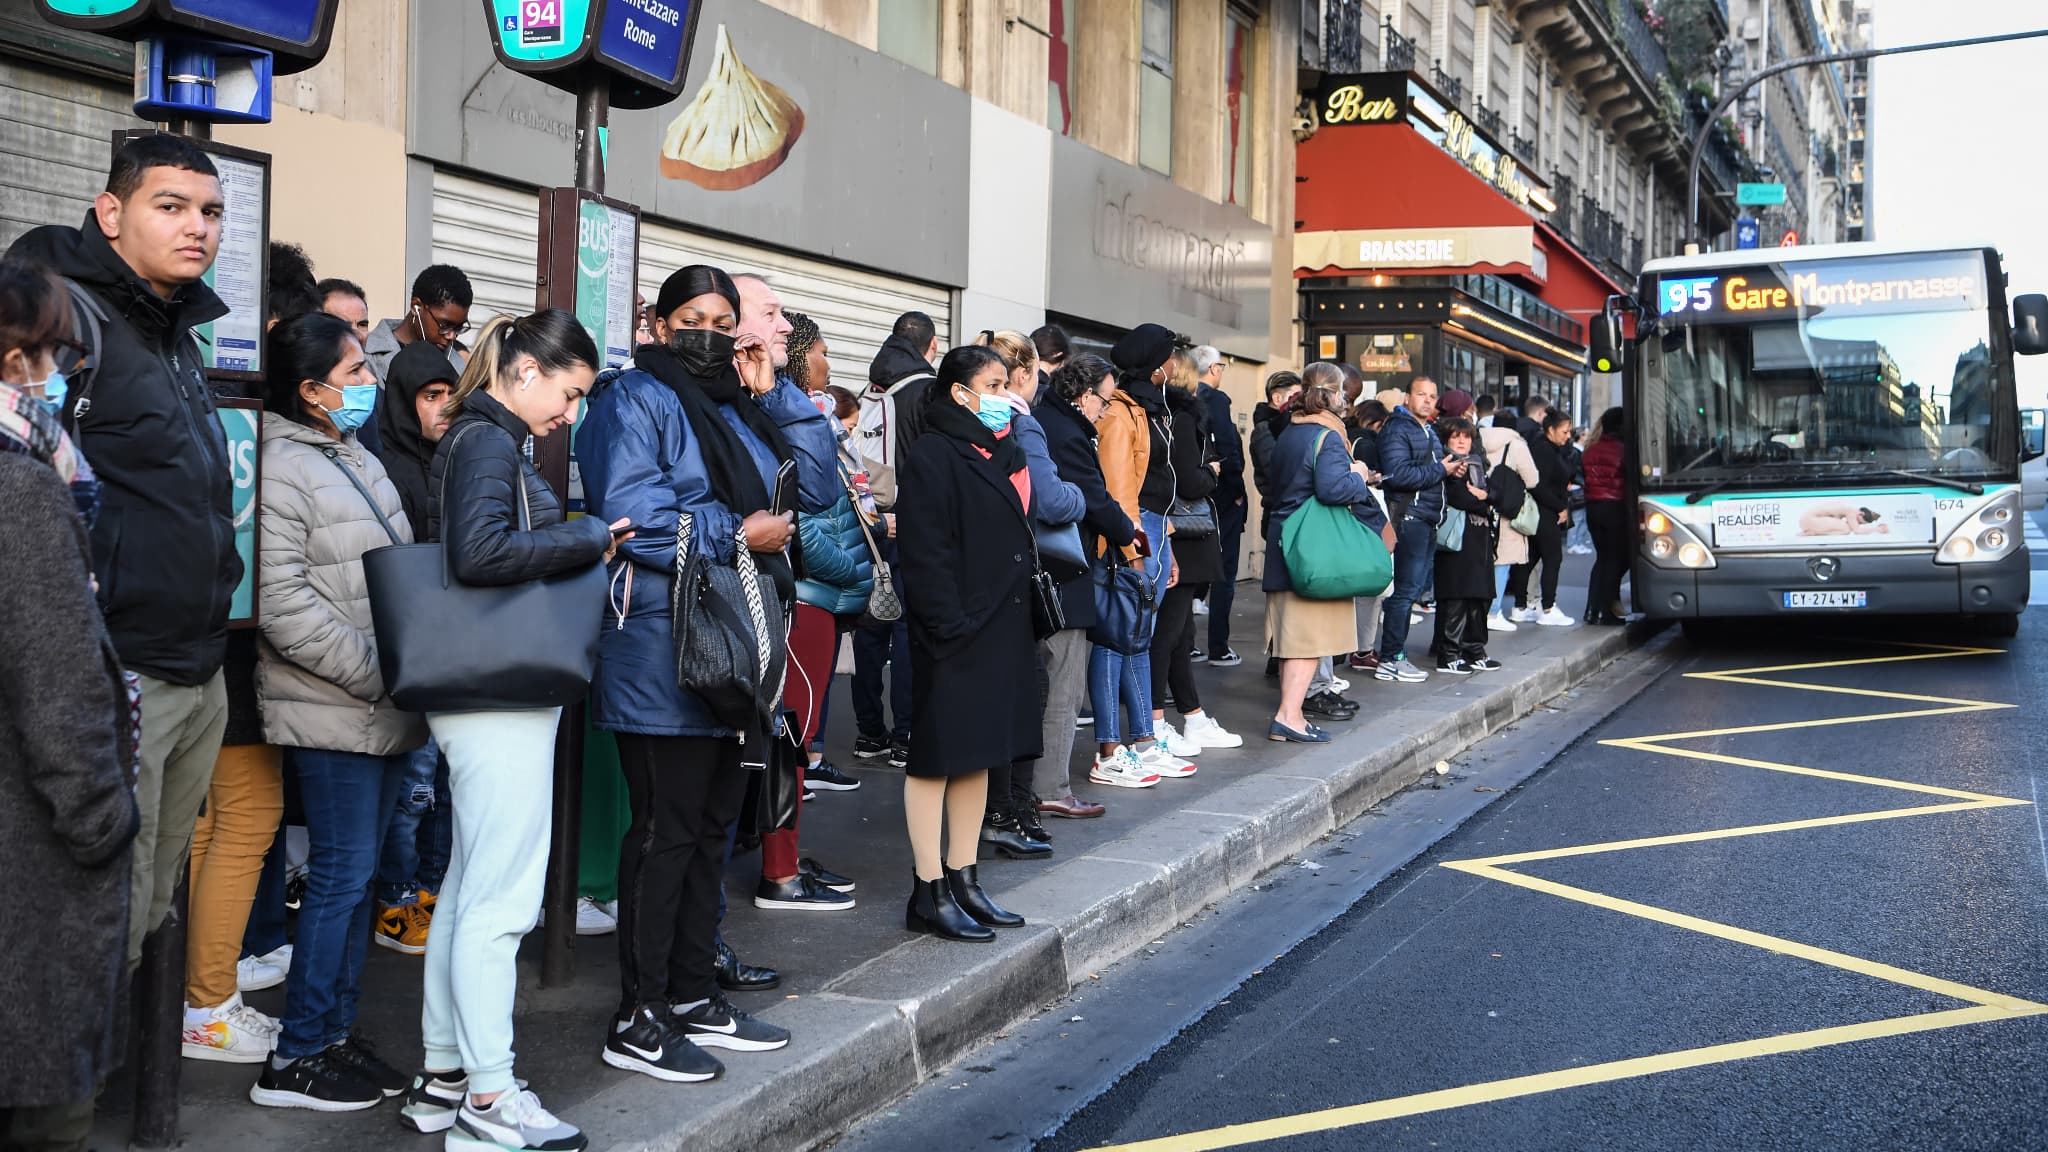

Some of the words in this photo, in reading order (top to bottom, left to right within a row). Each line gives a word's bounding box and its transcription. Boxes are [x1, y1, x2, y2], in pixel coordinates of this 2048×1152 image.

[525, 1, 557, 27] 94
[623, 0, 679, 27] t-Lazare
[623, 17, 656, 50] Rome
[1325, 84, 1397, 123] Bar
[579, 216, 609, 252] BUS
[1360, 240, 1455, 262] BRASSERIE
[1668, 281, 1713, 313] 95
[1725, 277, 1788, 310] Gare
[1793, 273, 1975, 307] Montparnasse
[1739, 503, 1781, 515] HYPER
[1934, 499, 1964, 510] 1674
[1718, 513, 1782, 526] REALISME
[1792, 593, 1857, 606] CY-274-WY
